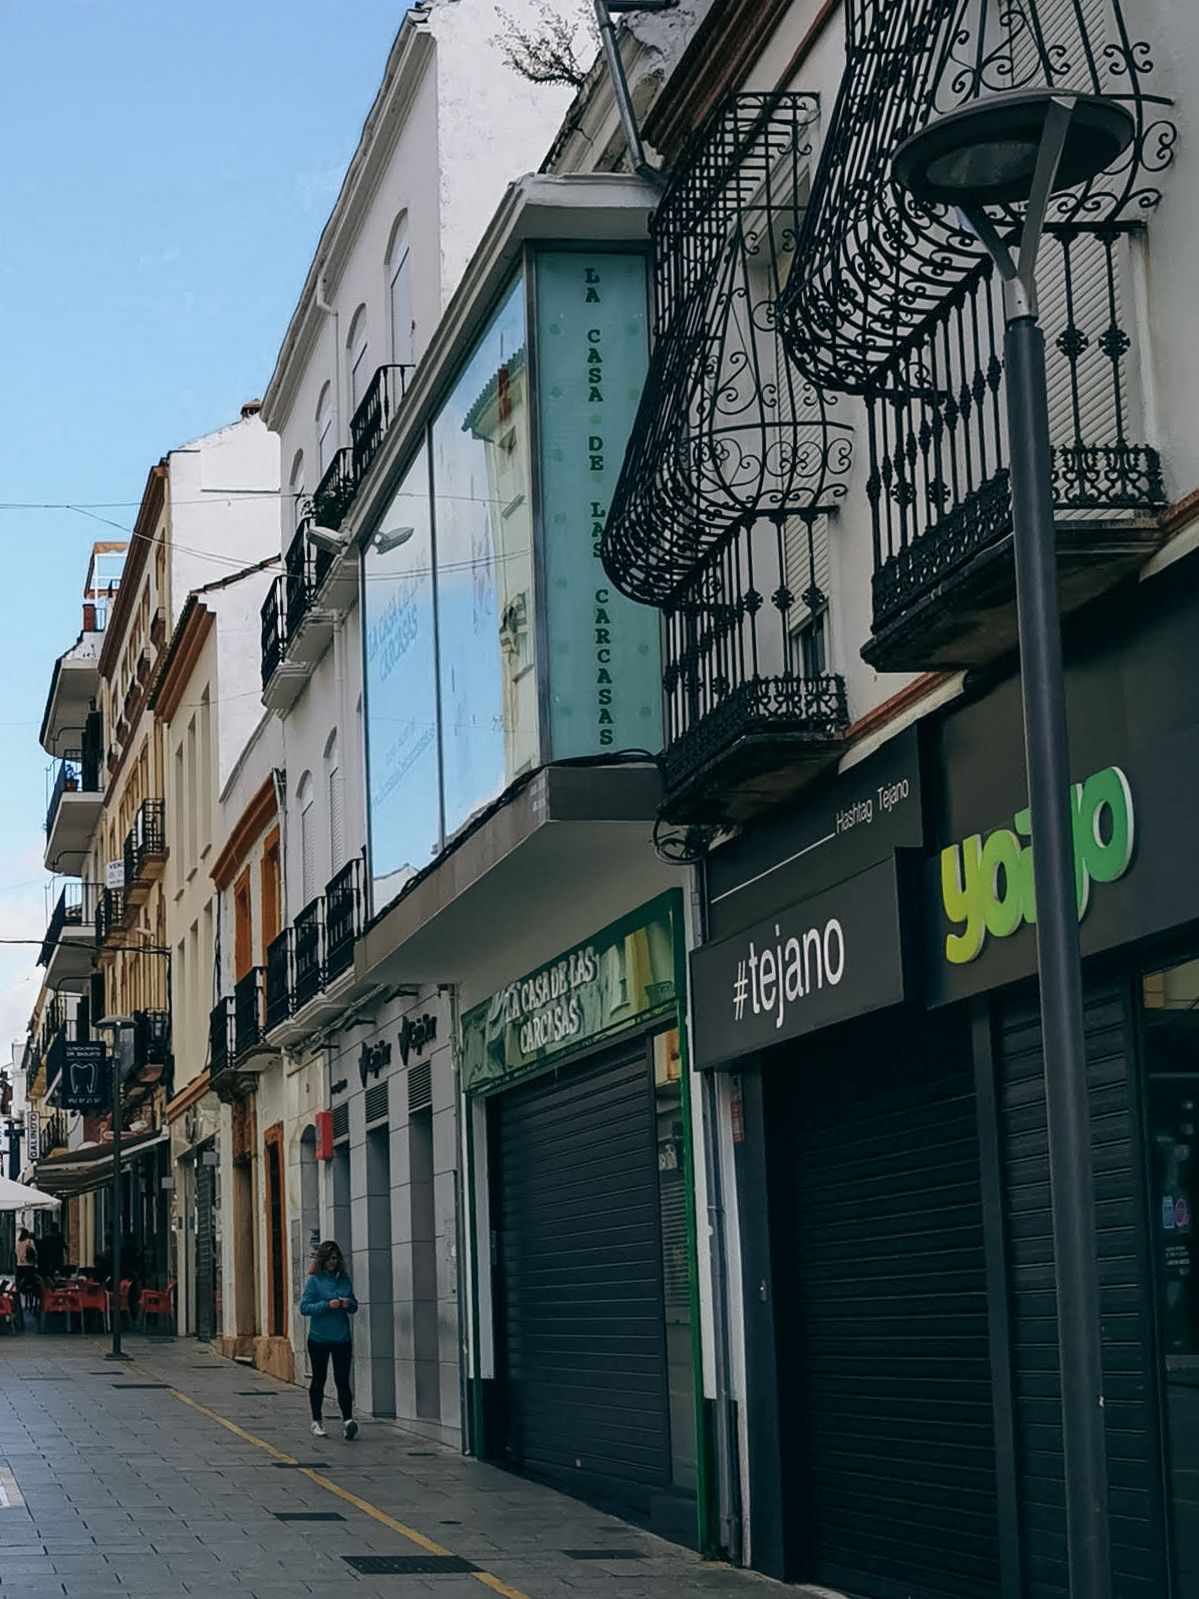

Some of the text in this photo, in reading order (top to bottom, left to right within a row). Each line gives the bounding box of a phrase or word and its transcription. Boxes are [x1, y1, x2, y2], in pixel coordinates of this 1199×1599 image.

[585, 268, 614, 745] LA CASA DE LAS CARCASAS
[836, 778, 909, 833] Hashtag Tejano
[521, 971, 550, 1012] CASA
[551, 961, 568, 999] DE
[569, 946, 595, 988] LAS
[733, 919, 844, 1028] #tejano
